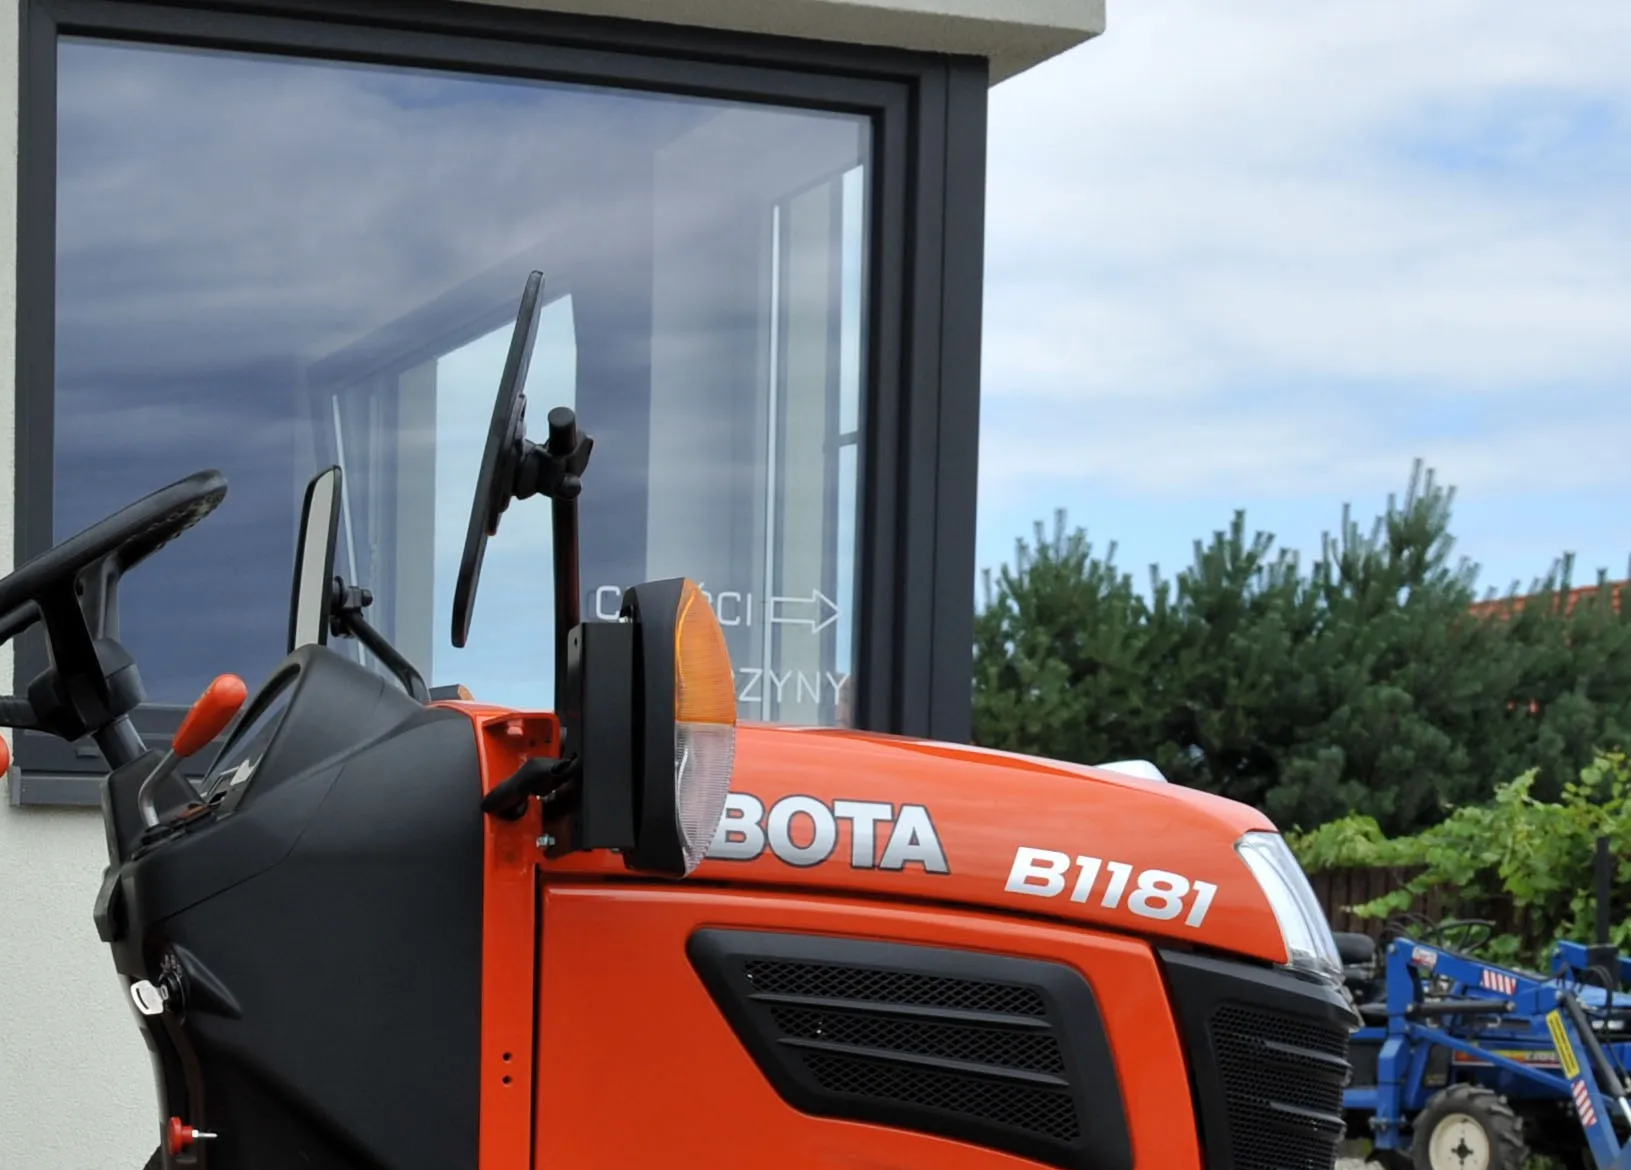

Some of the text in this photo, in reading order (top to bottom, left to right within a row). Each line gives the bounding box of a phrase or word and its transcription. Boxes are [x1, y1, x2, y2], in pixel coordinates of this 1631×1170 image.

[595, 582, 752, 627] CCI
[732, 667, 852, 705] ZYNY
[704, 791, 950, 875] BOTA
[1003, 846, 1218, 928] B1181
